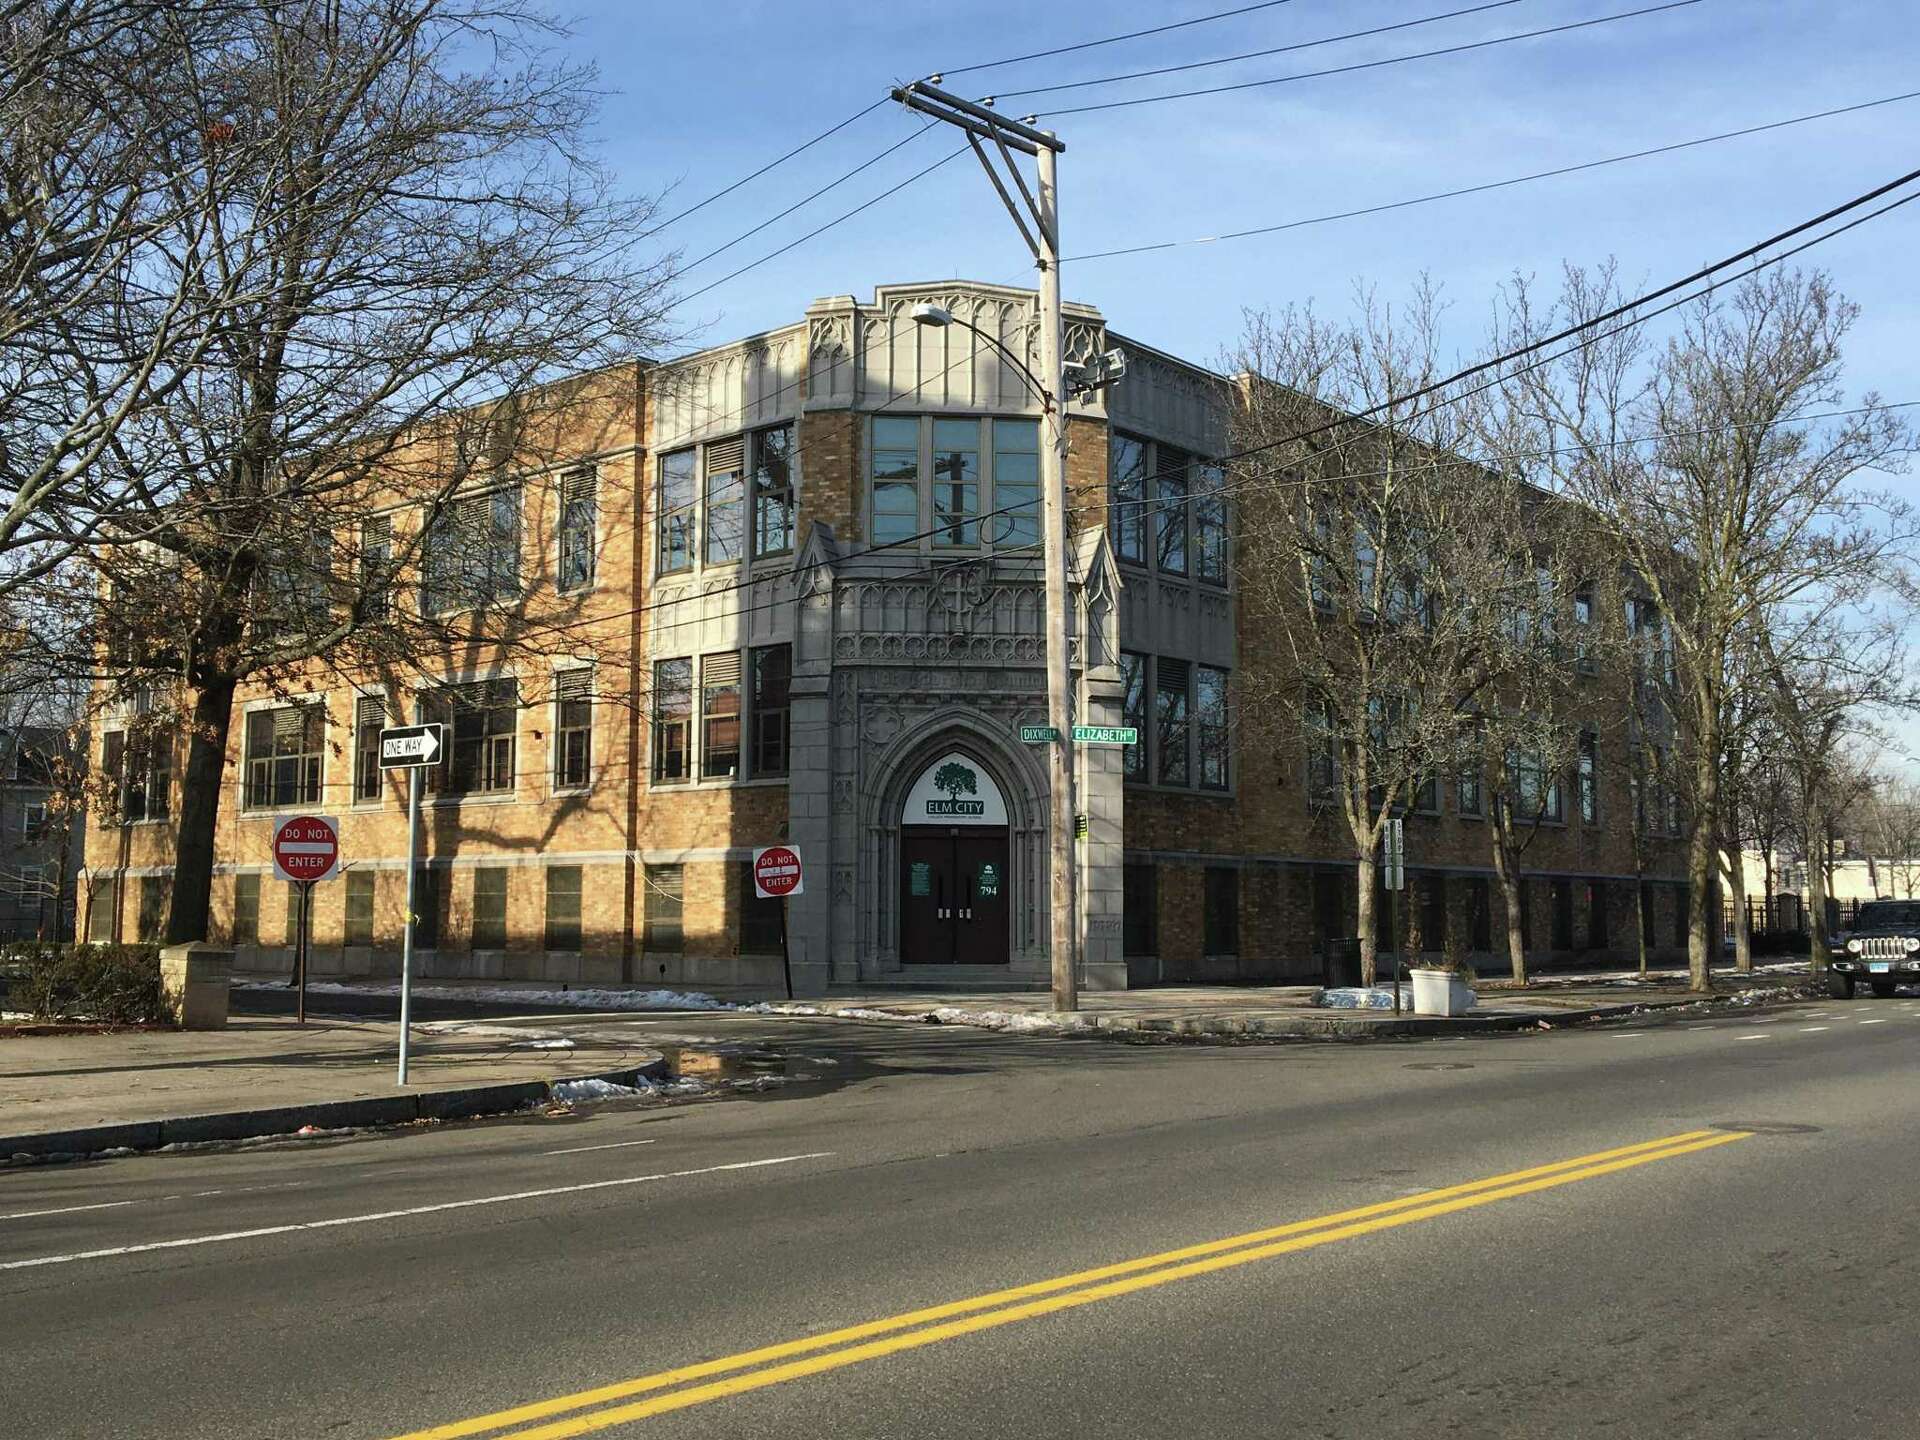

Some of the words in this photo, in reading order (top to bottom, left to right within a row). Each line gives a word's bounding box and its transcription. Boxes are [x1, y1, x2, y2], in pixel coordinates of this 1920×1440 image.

[1075, 728, 1127, 741] ELIZABETH
[385, 740, 402, 756] ONE
[404, 738, 422, 754] WAY
[928, 802, 952, 813] ELM
[955, 802, 982, 813] CITY
[285, 828, 300, 839] DO
[307, 828, 329, 840] NOT
[288, 856, 324, 868] ENTER
[761, 857, 773, 866] DO
[777, 855, 794, 865] NOT
[766, 876, 793, 888] ENTER
[980, 886, 997, 896] 794
